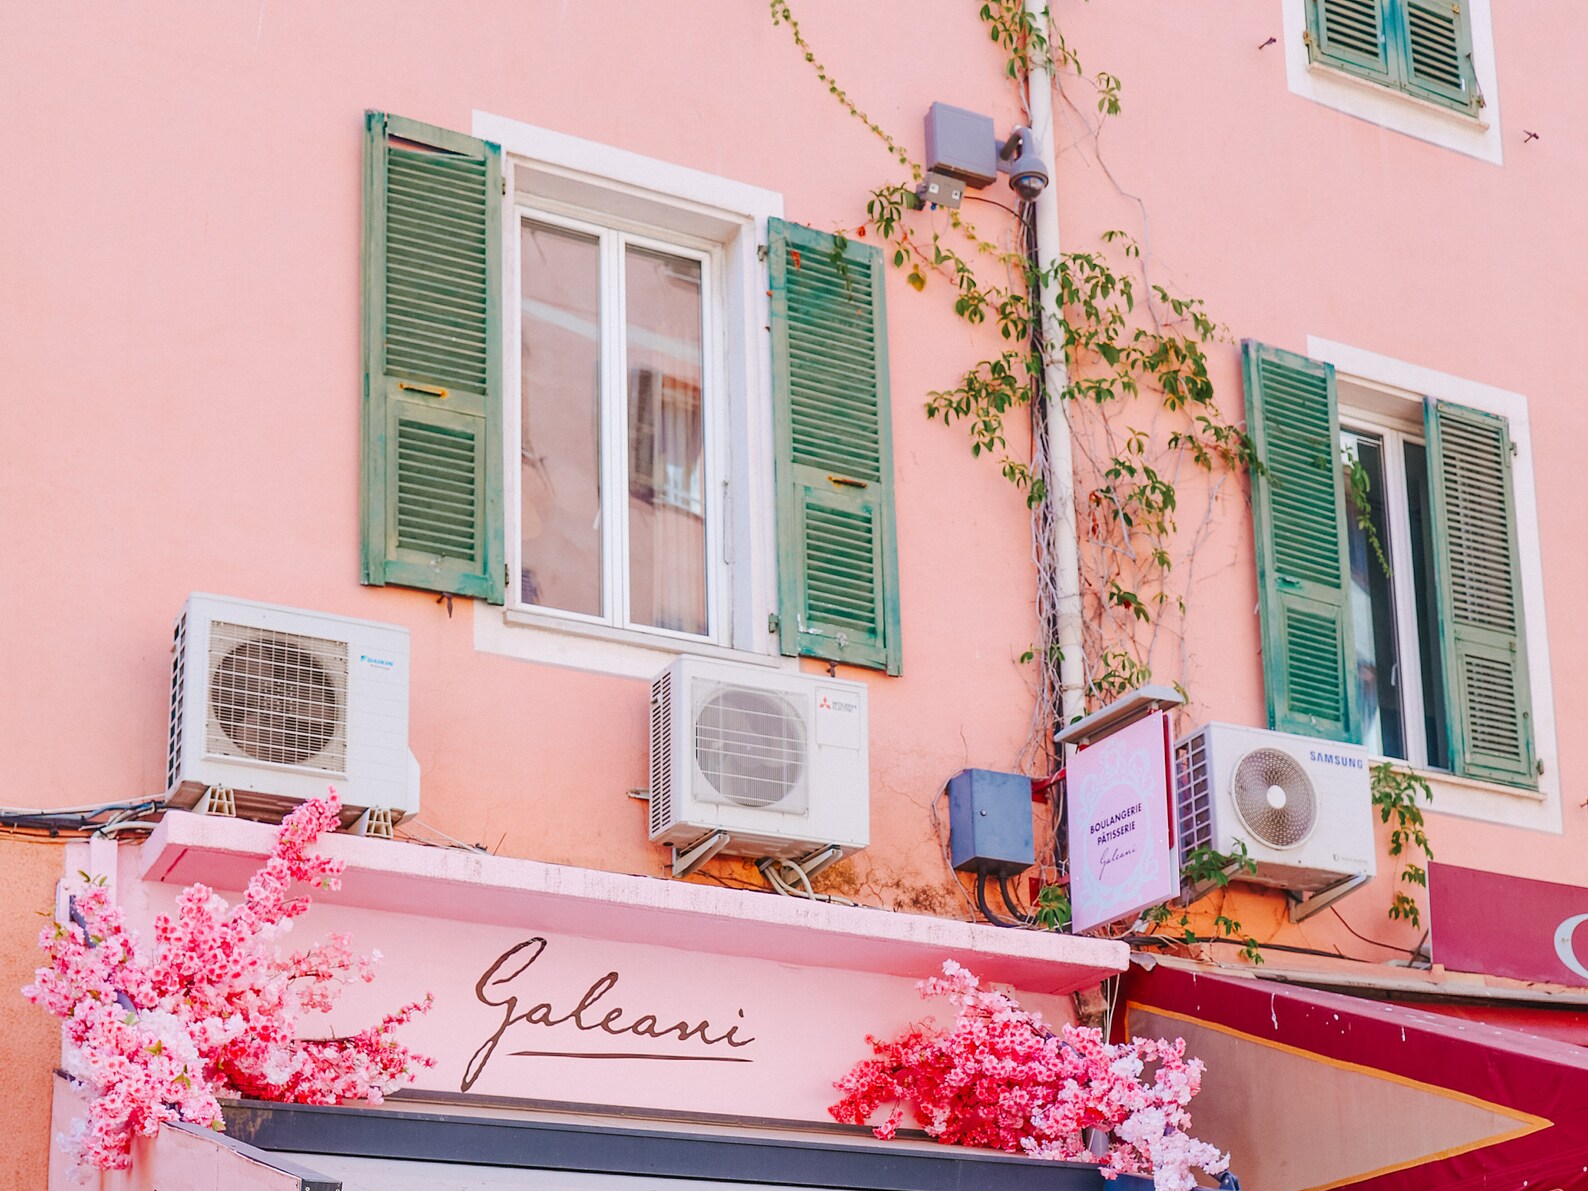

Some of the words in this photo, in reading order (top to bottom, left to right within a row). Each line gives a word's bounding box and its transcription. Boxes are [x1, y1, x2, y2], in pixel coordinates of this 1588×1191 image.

[1309, 750, 1364, 769] SAMSUNG
[1090, 802, 1142, 835] BOULANGERIE
[1097, 820, 1136, 846] PÂTISSERIE
[1098, 846, 1137, 881] Galeani
[460, 936, 756, 1093] Galeani
